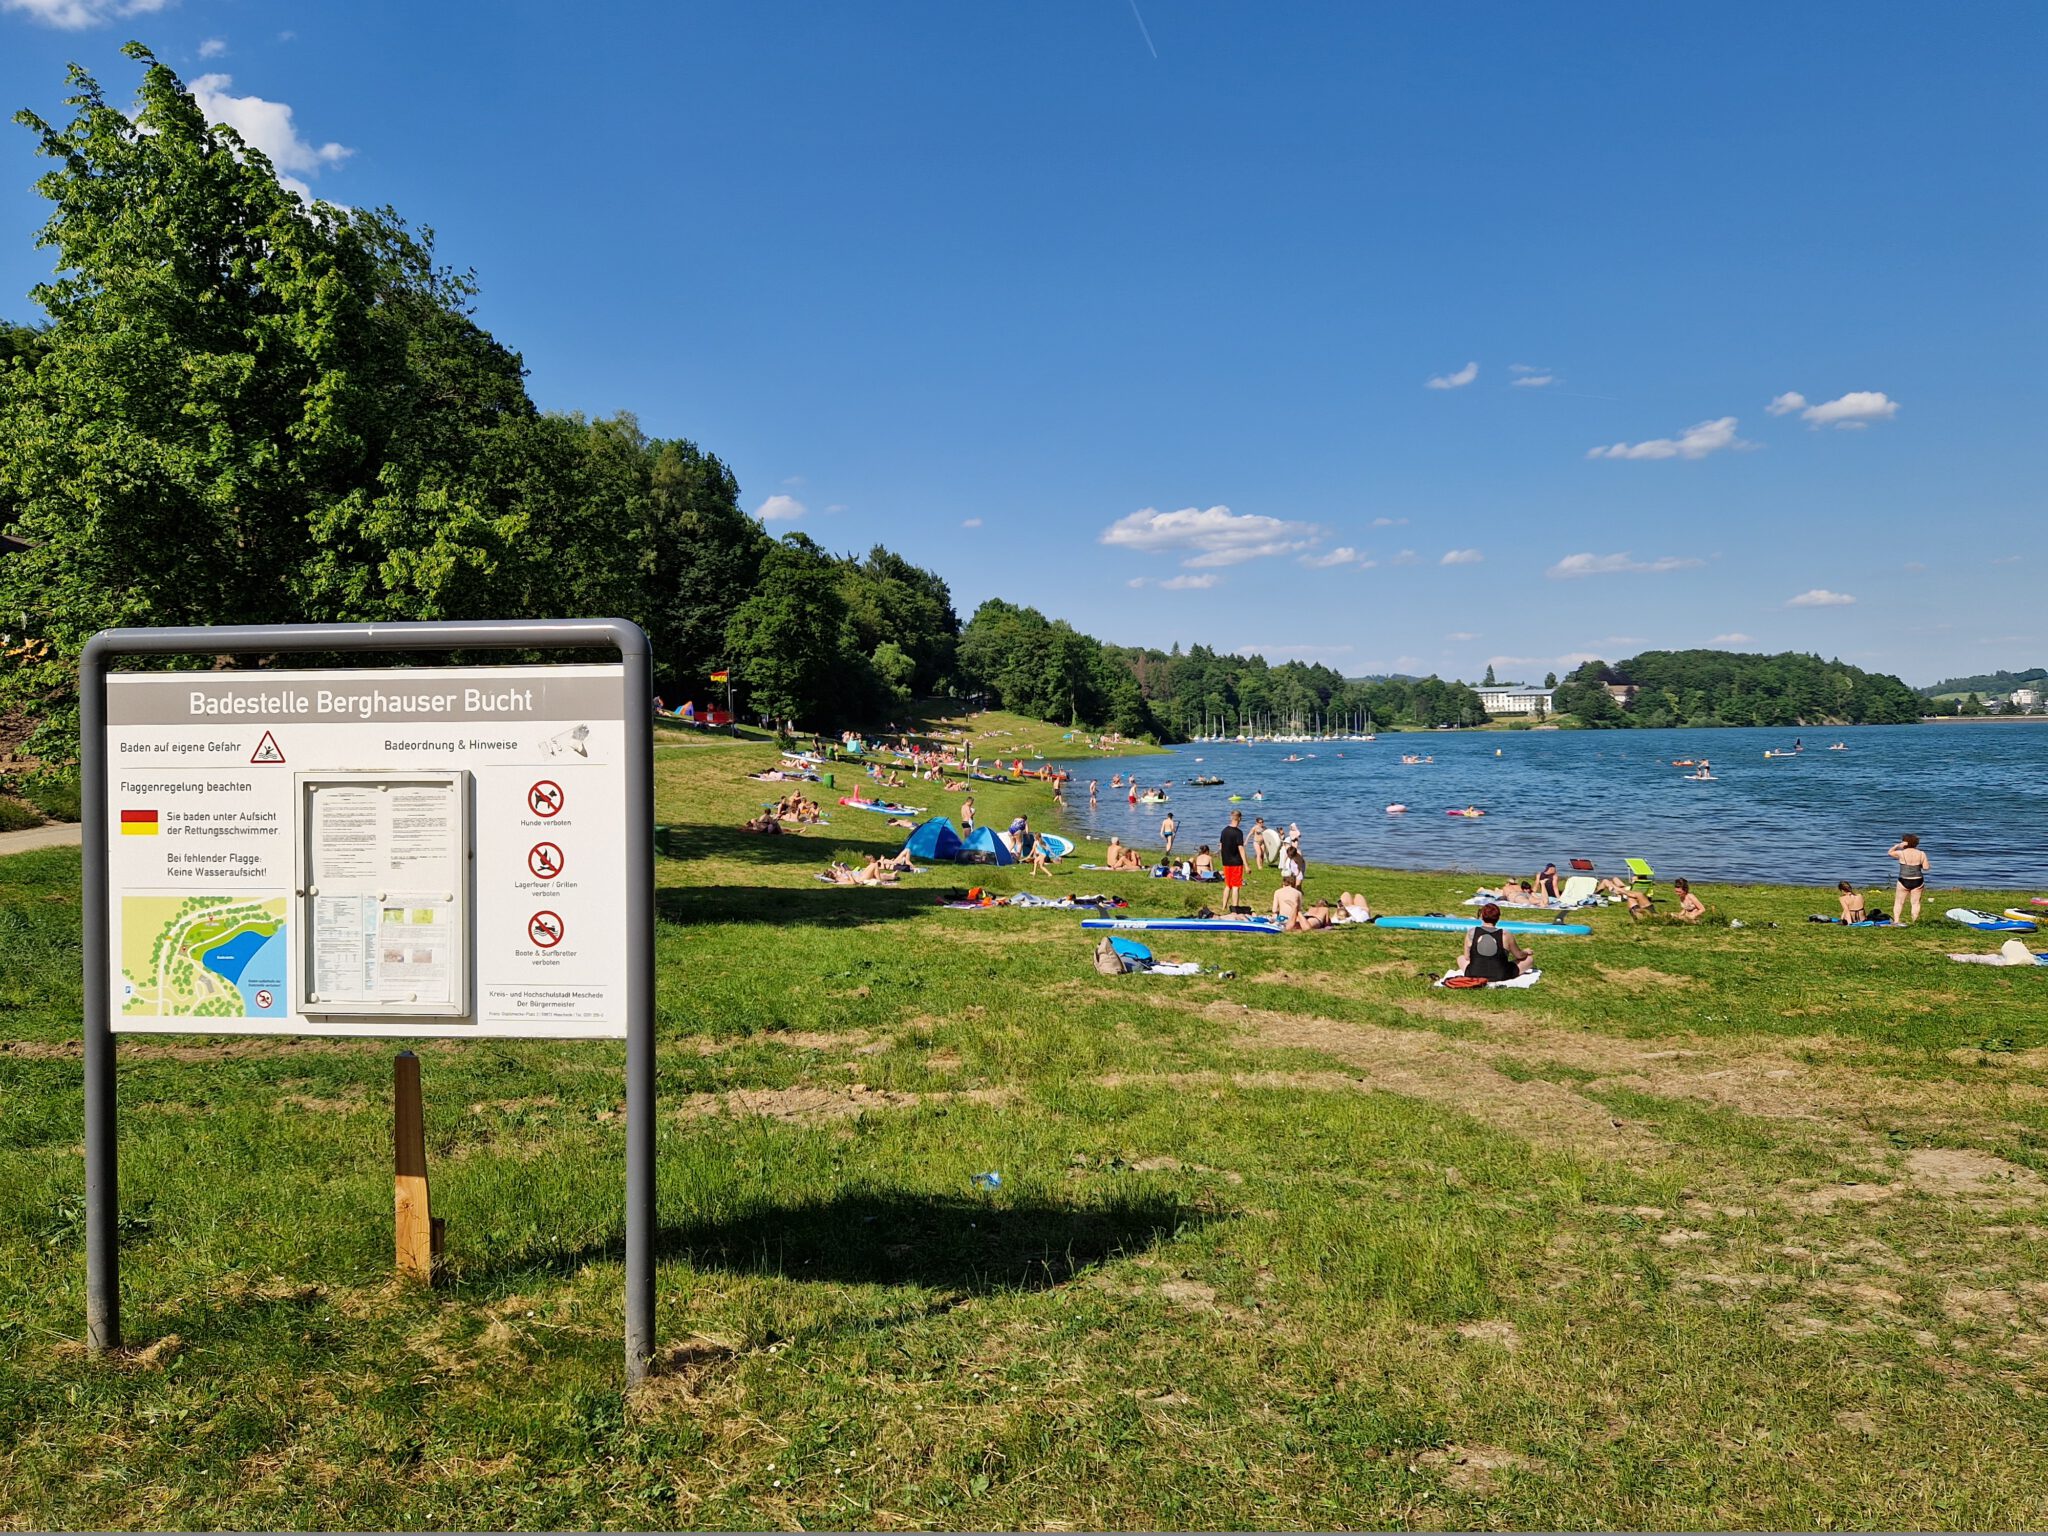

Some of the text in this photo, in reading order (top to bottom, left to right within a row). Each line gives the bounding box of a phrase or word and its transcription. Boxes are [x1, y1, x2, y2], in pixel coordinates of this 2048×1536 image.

[190, 688, 534, 719] Badestelle Berghauser Bucht
[120, 741, 242, 755] Baden auf eigene Gefahr
[384, 739, 518, 753] Badeordnung & Hinweise
[120, 781, 252, 795] Flaggenregelung beachten
[166, 811, 277, 822] Sie baden unter Aufsicht
[520, 819, 571, 827] Hunde verboten
[166, 825, 183, 835] der
[167, 852, 262, 866] Bei fehlender Flagge:
[167, 865, 267, 877] Keine Wasseraufsicht!
[514, 880, 550, 890] Lagerfeuer
[556, 880, 578, 889] Grillen
[531, 889, 561, 897] verboten
[514, 949, 534, 957] Boote
[541, 949, 578, 958] Surfbretter
[531, 958, 561, 966] verboten
[488, 990, 604, 999] Kreis- und Hochschulstadt Meschede
[516, 1000, 576, 1010] Der Bürgermeister
